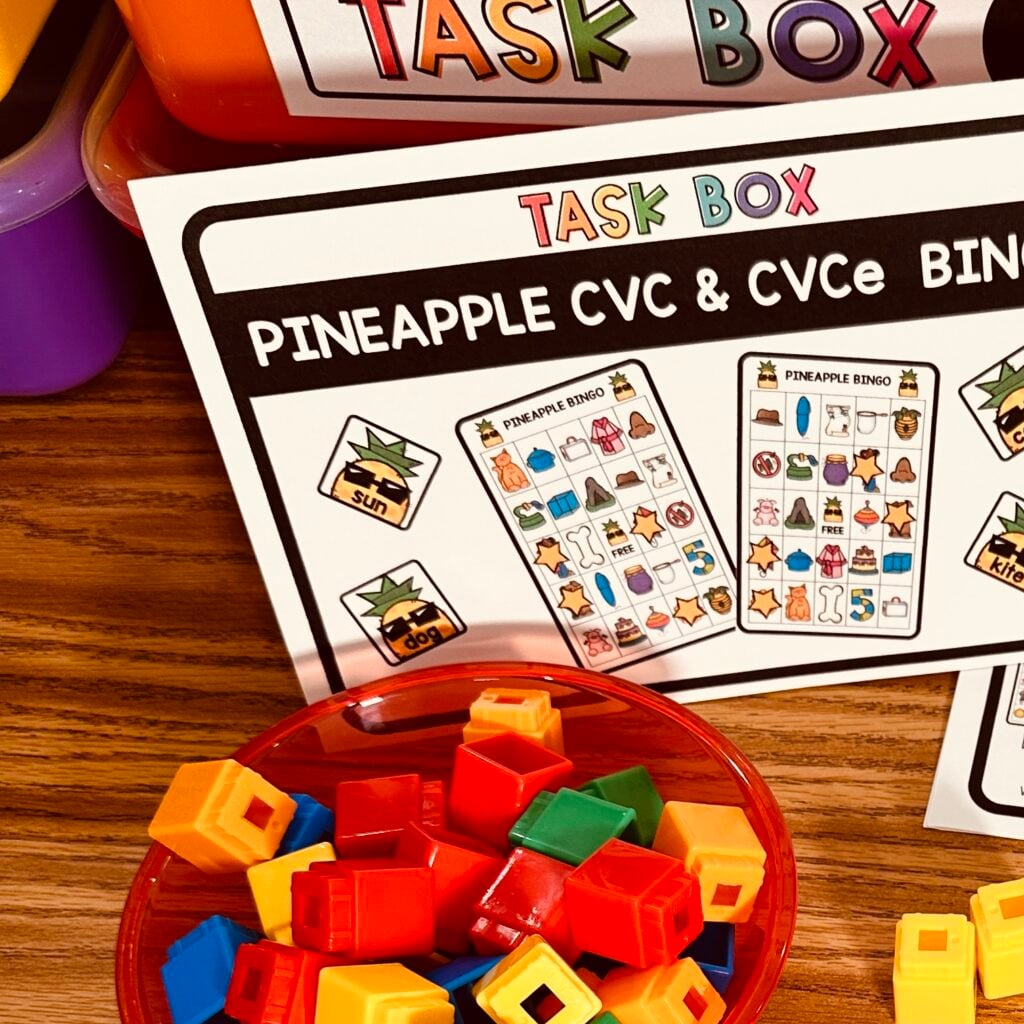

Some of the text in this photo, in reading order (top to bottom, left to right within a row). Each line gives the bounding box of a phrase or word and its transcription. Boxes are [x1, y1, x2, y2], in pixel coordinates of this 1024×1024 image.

[339, 0, 938, 89] TASK BOX
[518, 164, 820, 247] TASK BOX
[247, 287, 556, 367] PINEAPPLE
[570, 273, 678, 327] CVC
[696, 268, 730, 312] &
[747, 253, 886, 303] CVCe
[785, 370, 892, 388] PINEAPPLE BINGO
[503, 387, 605, 430] PINEAPPLE BINGO
[350, 487, 388, 516] sun
[821, 524, 844, 536] FREE
[611, 545, 635, 559] FREE
[989, 555, 1024, 584] kite
[404, 622, 443, 653] dog
